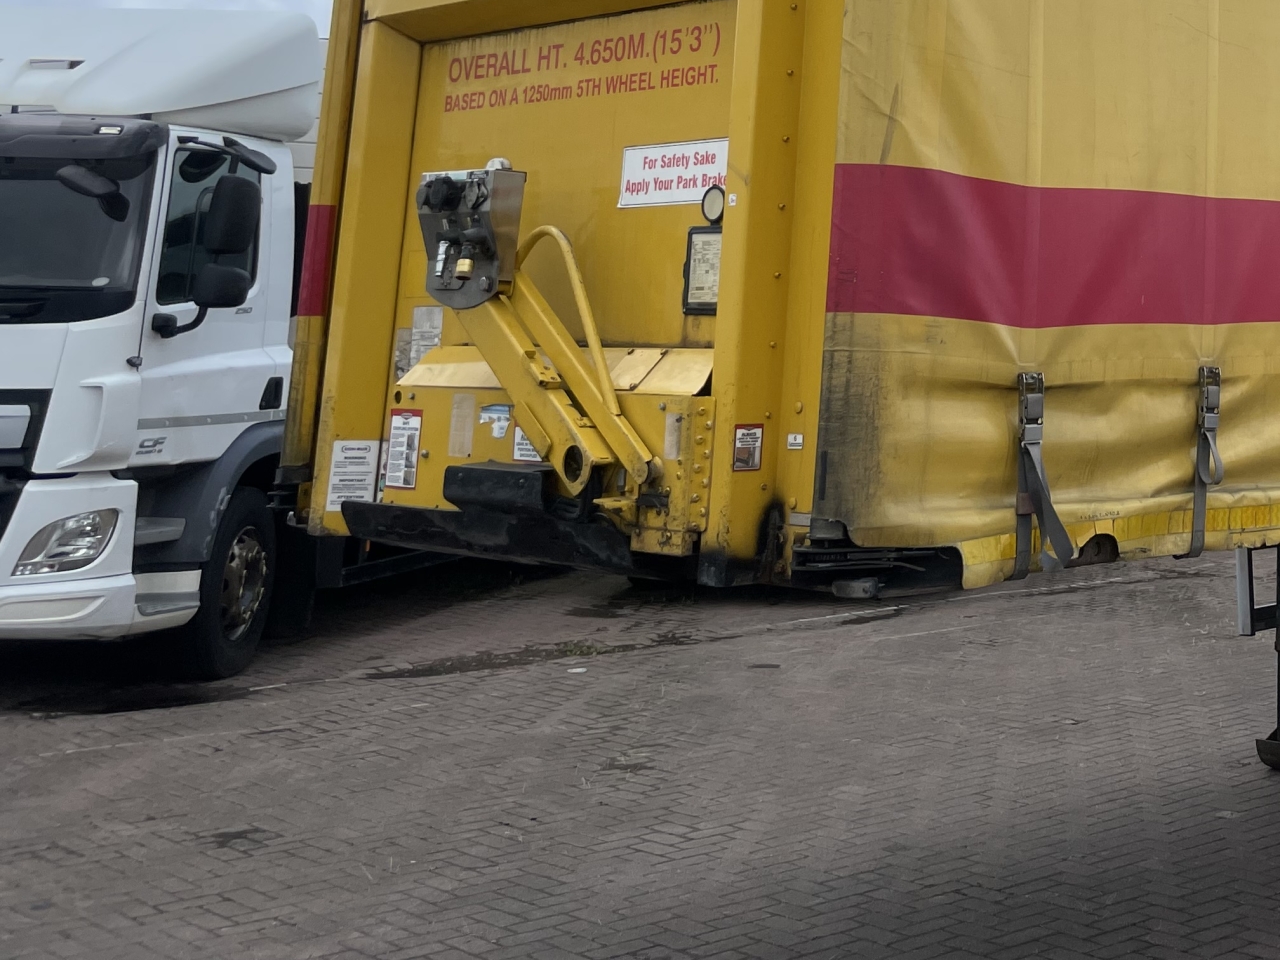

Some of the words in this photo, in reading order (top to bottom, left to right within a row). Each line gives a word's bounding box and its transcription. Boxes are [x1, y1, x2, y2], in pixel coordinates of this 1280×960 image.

[449, 47, 531, 83] OVERALL
[537, 43, 567, 71] HT.
[444, 91, 485, 113] BASED
[488, 89, 507, 108] ON
[509, 87, 519, 106] A
[522, 83, 573, 104] 1250mm
[576, 77, 601, 99] 5TH
[605, 71, 656, 95] WHEEL
[660, 64, 719, 89] HEIGHT.
[643, 156, 658, 170] For
[660, 153, 690, 170] Safety
[693, 151, 716, 166] Sake
[625, 178, 650, 196] Apply
[653, 177, 674, 191] Your
[676, 174, 698, 189] Park
[138, 436, 168, 448] CF
